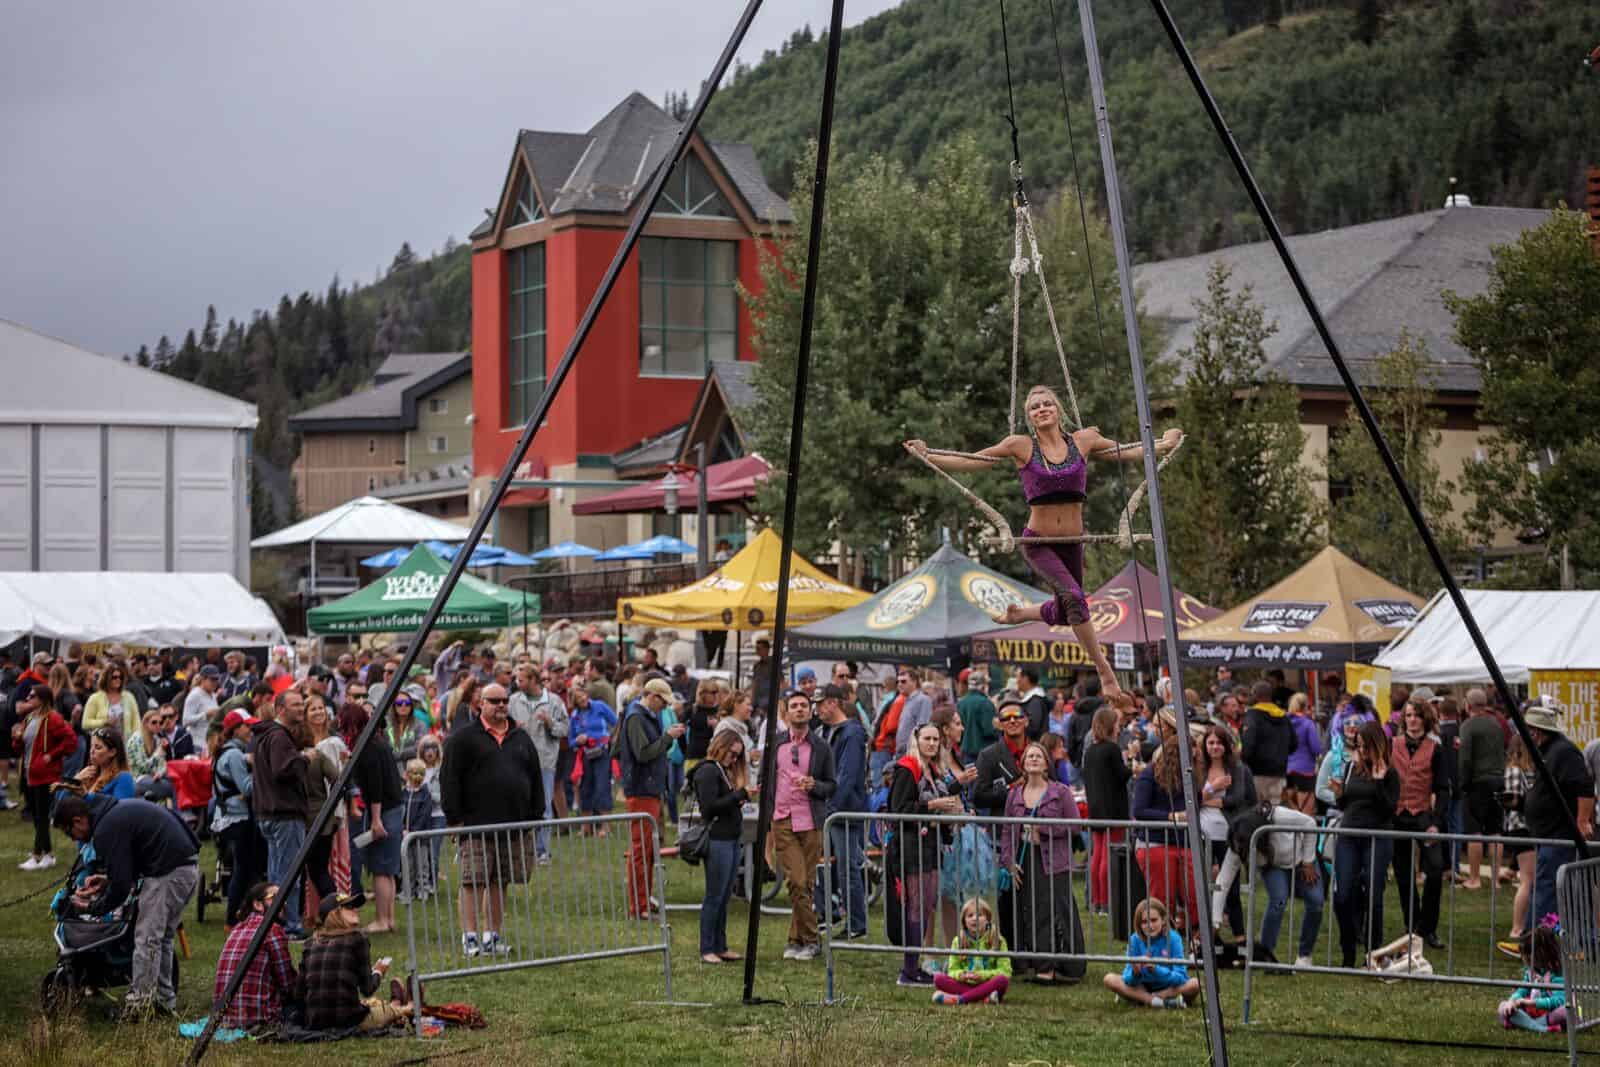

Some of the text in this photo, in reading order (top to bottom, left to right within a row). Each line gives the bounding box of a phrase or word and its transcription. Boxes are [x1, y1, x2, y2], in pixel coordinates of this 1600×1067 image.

[1251, 608, 1319, 622] PIKES PEAK
[995, 639, 1047, 662] WILD
[1049, 640, 1108, 666] CID
[1235, 643, 1250, 658] the
[1254, 644, 1281, 662] Craft
[1282, 645, 1297, 662] of
[1296, 645, 1323, 661] Beer
[1568, 682, 1599, 704] THE
